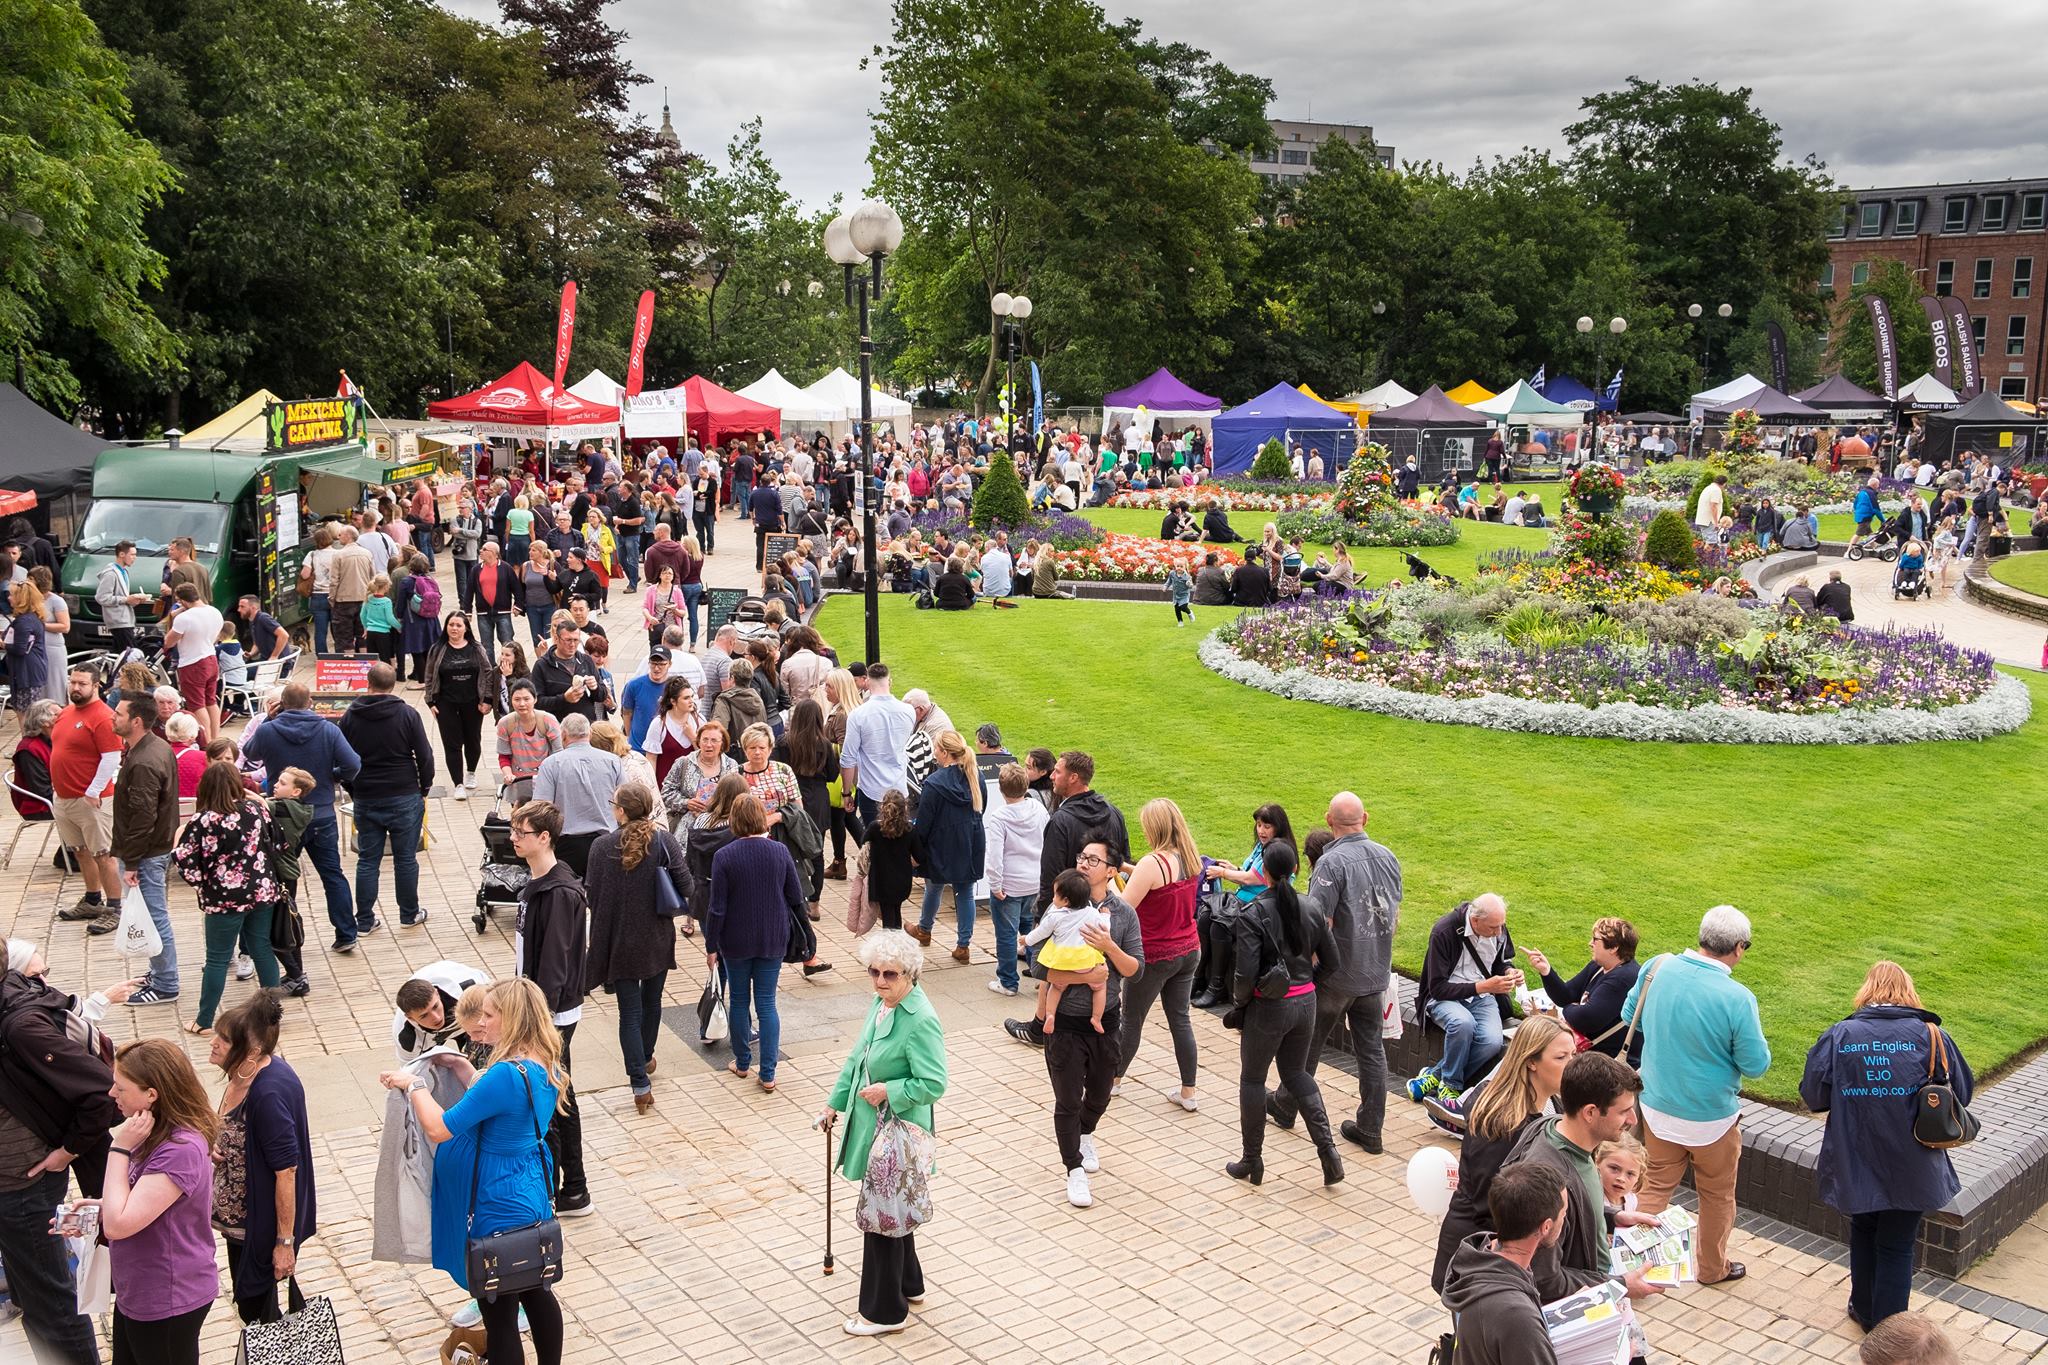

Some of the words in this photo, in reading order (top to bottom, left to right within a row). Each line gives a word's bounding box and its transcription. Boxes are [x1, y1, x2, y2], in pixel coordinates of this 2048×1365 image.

[632, 313, 648, 369] Burgers
[1877, 315, 1891, 359] GOURMET
[1931, 319, 1949, 369] BIGOS
[1954, 313, 1968, 346] POLISH
[1961, 346, 1974, 388] SAUSAGE
[286, 401, 345, 424] MEXICAN
[471, 410, 487, 418] Made
[1911, 402, 1942, 410] Gourmet
[288, 420, 344, 445] CANTINA
[1839, 1042, 1869, 1053] Learn
[1872, 1041, 1916, 1054] English
[1863, 1056, 1890, 1066] With
[1866, 1070, 1892, 1081] EJO
